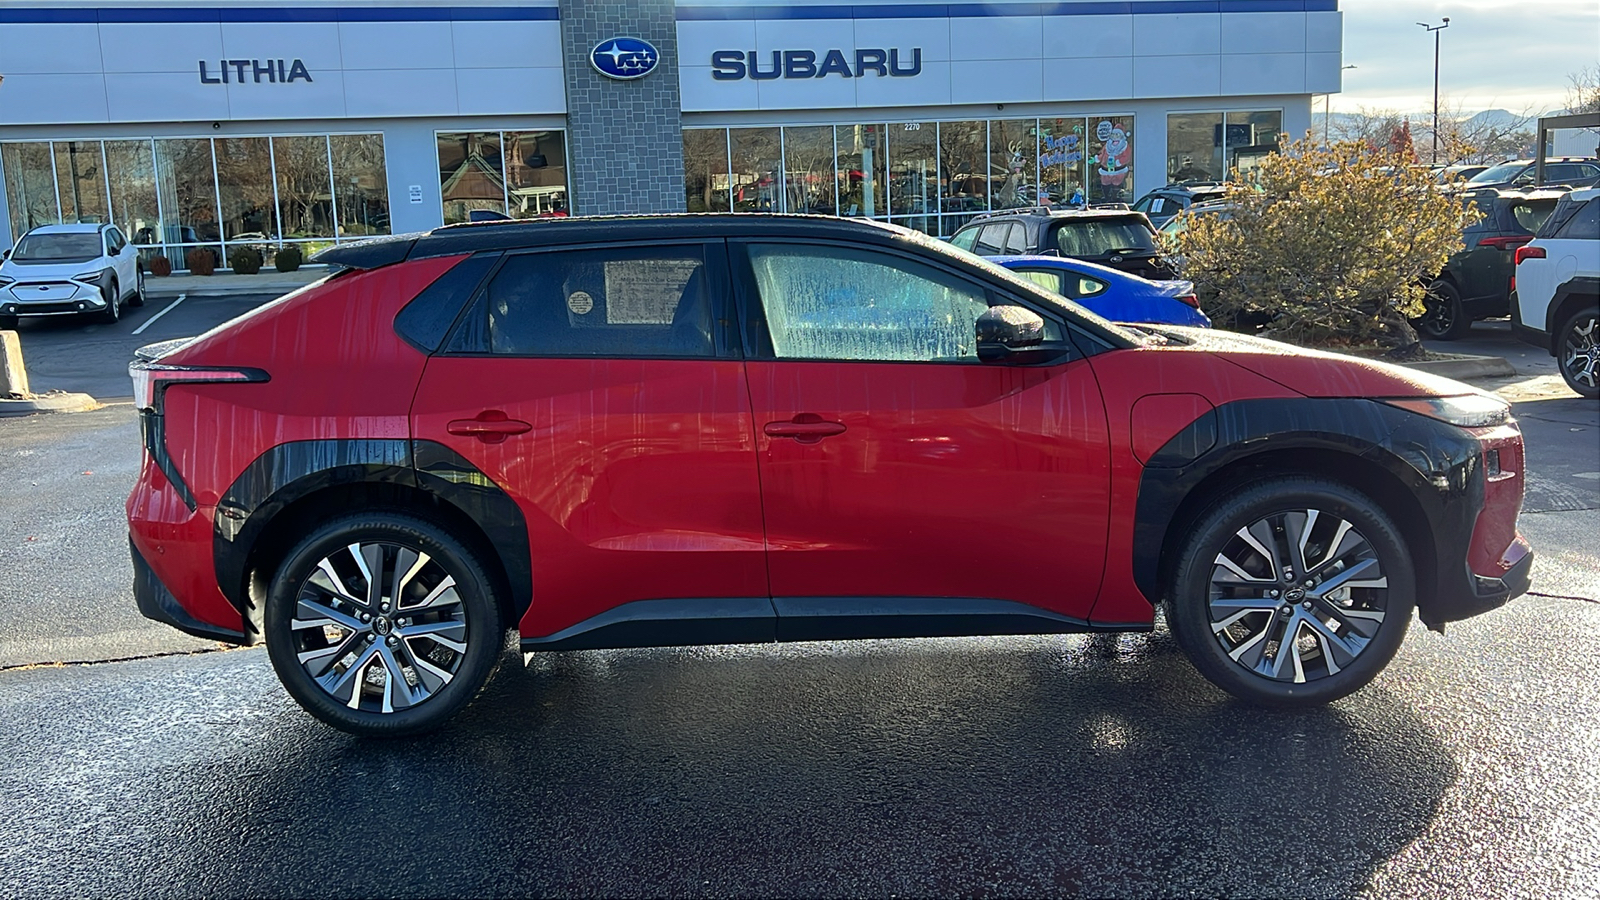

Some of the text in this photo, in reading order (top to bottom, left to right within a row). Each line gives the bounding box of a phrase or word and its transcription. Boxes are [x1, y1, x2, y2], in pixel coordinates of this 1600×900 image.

[198, 59, 313, 84] LITHIA
[711, 48, 922, 80] SUBARU
[904, 123, 921, 131] 2270
[1044, 134, 1079, 151] Happy
